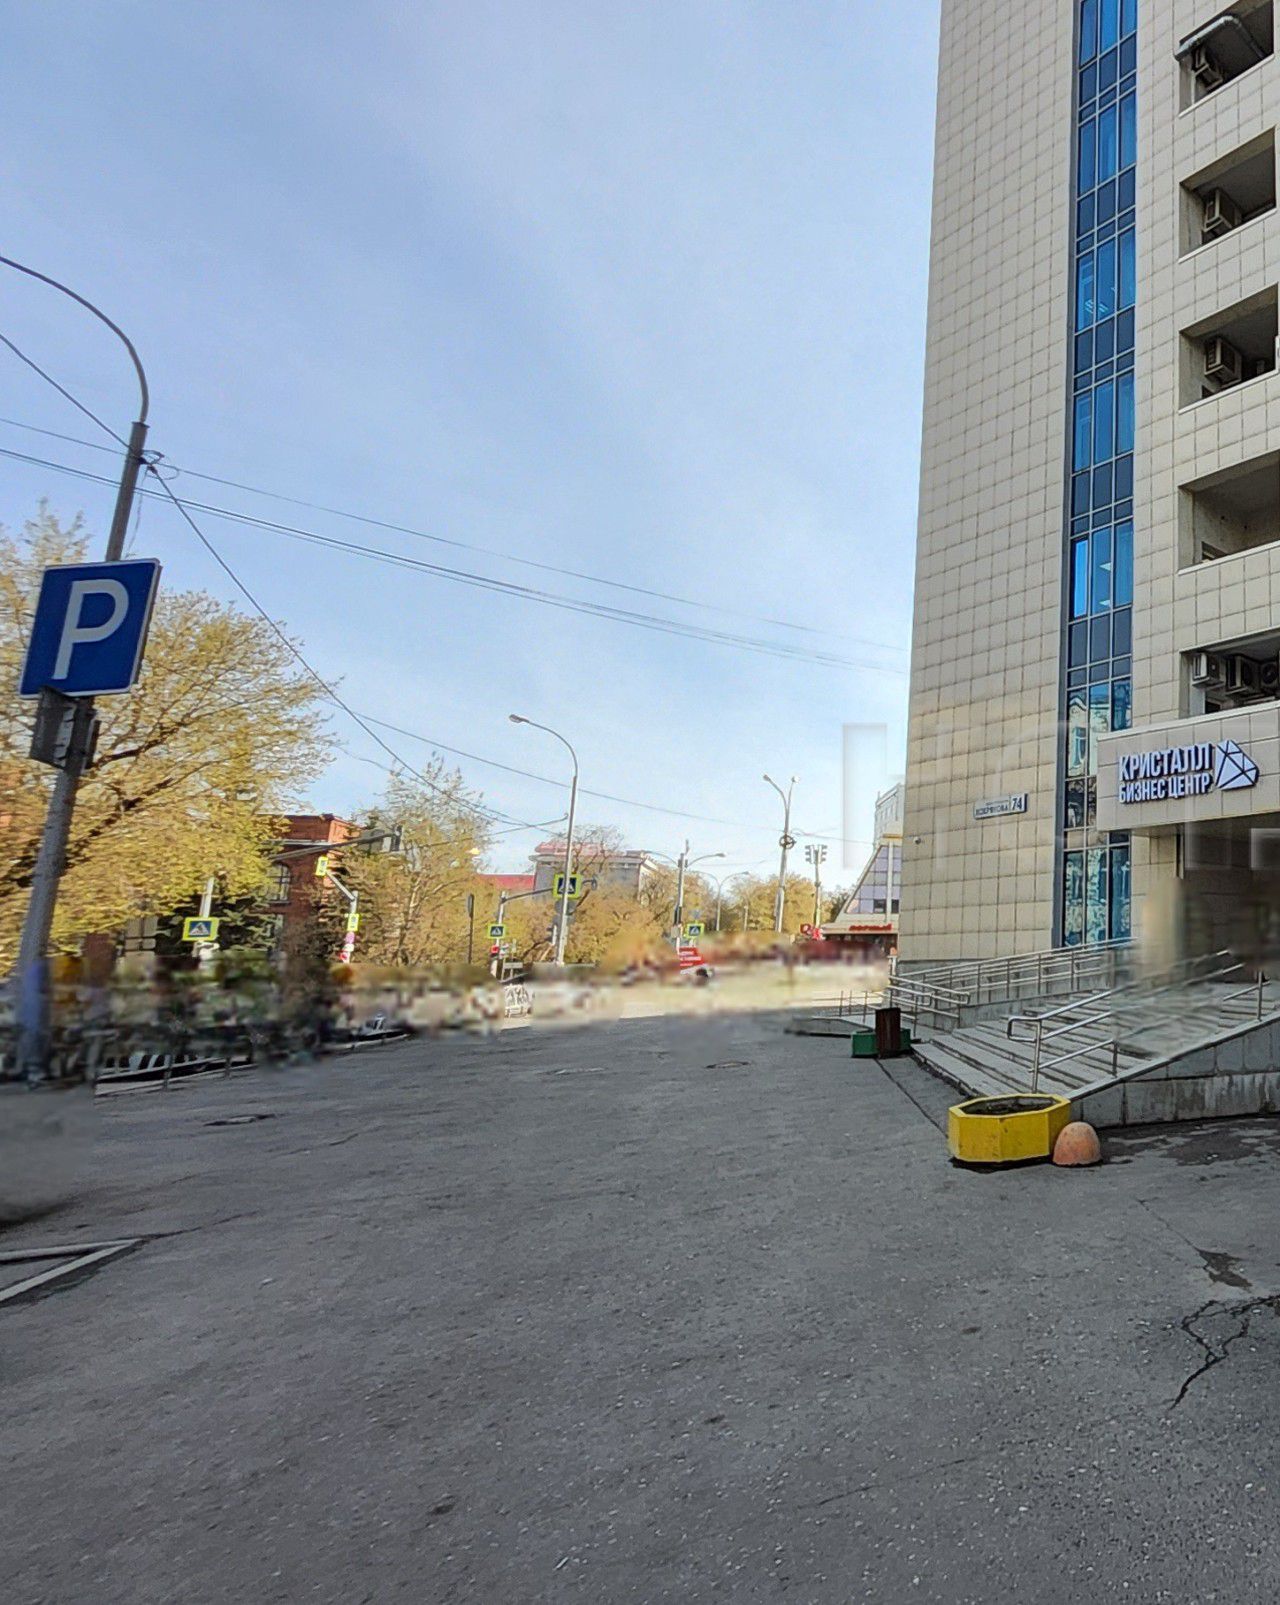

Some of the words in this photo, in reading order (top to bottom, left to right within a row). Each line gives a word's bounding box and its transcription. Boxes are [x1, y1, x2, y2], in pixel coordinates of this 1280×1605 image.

[51, 578, 130, 680] P
[1118, 743, 1212, 782] КРИСТАЛЛ
[1012, 797, 1023, 811] 74
[1118, 778, 1166, 804] БИЗНЕС
[1167, 772, 1211, 799] ЦЕНТР
